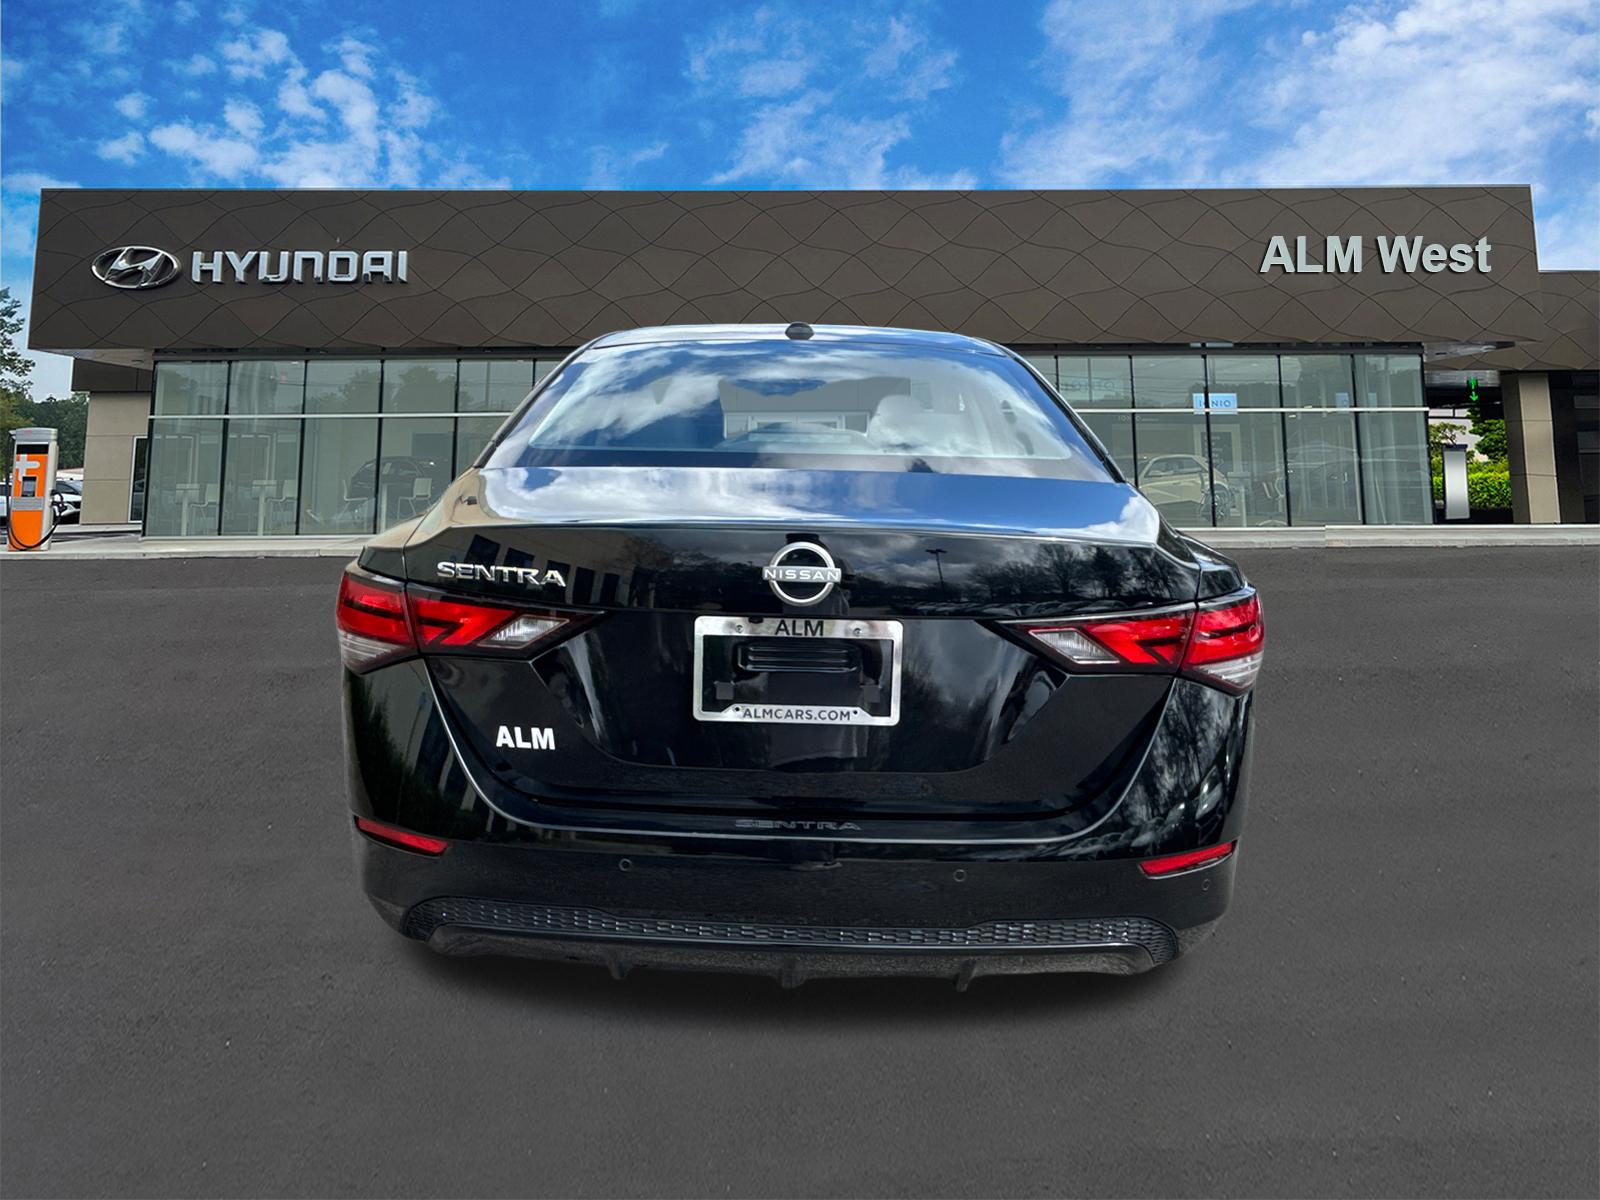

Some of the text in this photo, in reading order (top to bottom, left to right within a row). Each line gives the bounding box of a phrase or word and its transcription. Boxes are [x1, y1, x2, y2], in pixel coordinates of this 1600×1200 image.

[191, 250, 408, 284] HYUNDAI
[1260, 235, 1492, 273] ALM West
[437, 561, 567, 588] SENTRA
[764, 568, 839, 581] NISSAN
[775, 619, 824, 637] ALM
[742, 708, 851, 721] ALMCARS.COM
[495, 725, 556, 751] ALM
